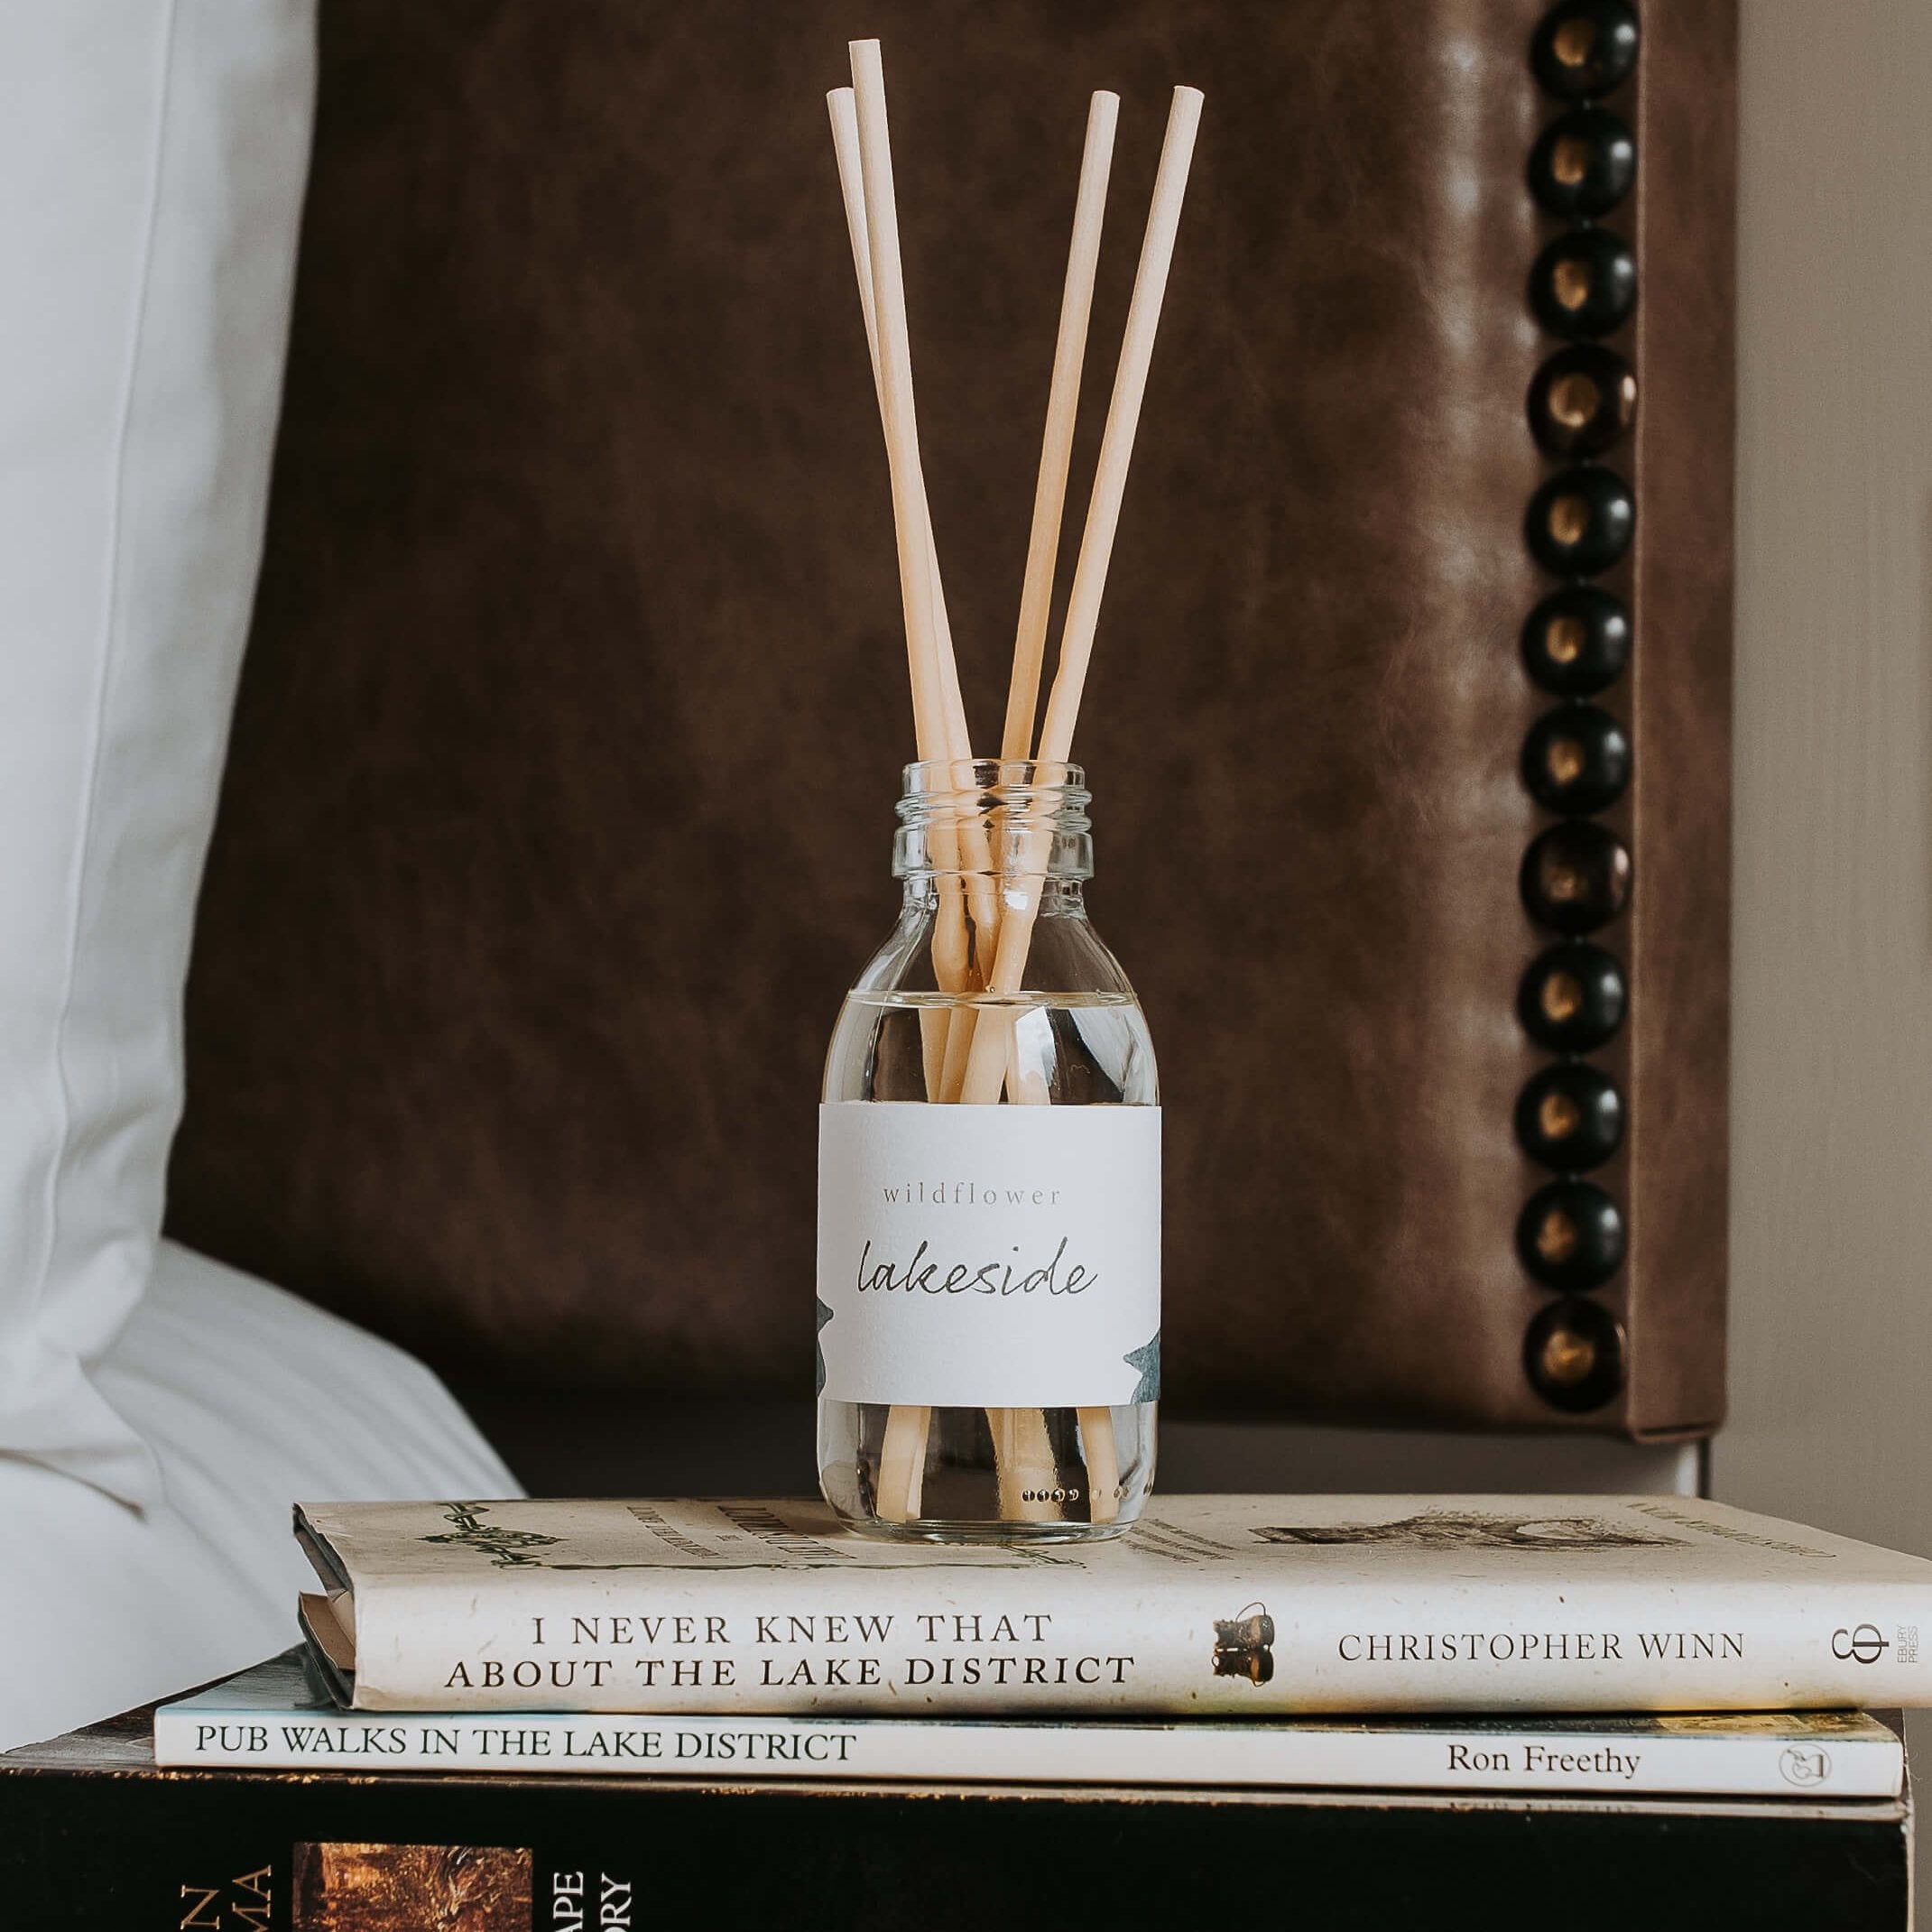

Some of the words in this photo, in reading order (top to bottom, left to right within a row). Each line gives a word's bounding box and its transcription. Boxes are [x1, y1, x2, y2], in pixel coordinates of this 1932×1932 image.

[882, 1181, 1062, 1206] wildflower
[857, 1236, 1098, 1296] lakeside
[532, 1616, 545, 1644] I
[571, 1616, 731, 1644] NEVER
[755, 1615, 894, 1643] KNEW
[917, 1614, 1052, 1642] THAT
[1338, 1633, 1623, 1661] CHRISTOPHER
[1638, 1633, 1744, 1659] WINN
[1897, 1624, 1907, 1663] EBURY
[1908, 1625, 1919, 1663] PRESS
[444, 1659, 613, 1687] ABOUT
[635, 1659, 736, 1687] THE
[760, 1658, 882, 1686] LAKE
[904, 1657, 1135, 1685] DISTRICT
[195, 1725, 268, 1752] PUB
[281, 1726, 406, 1754] WALKS
[420, 1728, 461, 1755] IN
[473, 1729, 550, 1757] THE
[563, 1730, 662, 1759] LAKE
[675, 1732, 857, 1761] DISTRICT
[1447, 1743, 1511, 1771] Ron
[1523, 1745, 1642, 1779] Freethy
